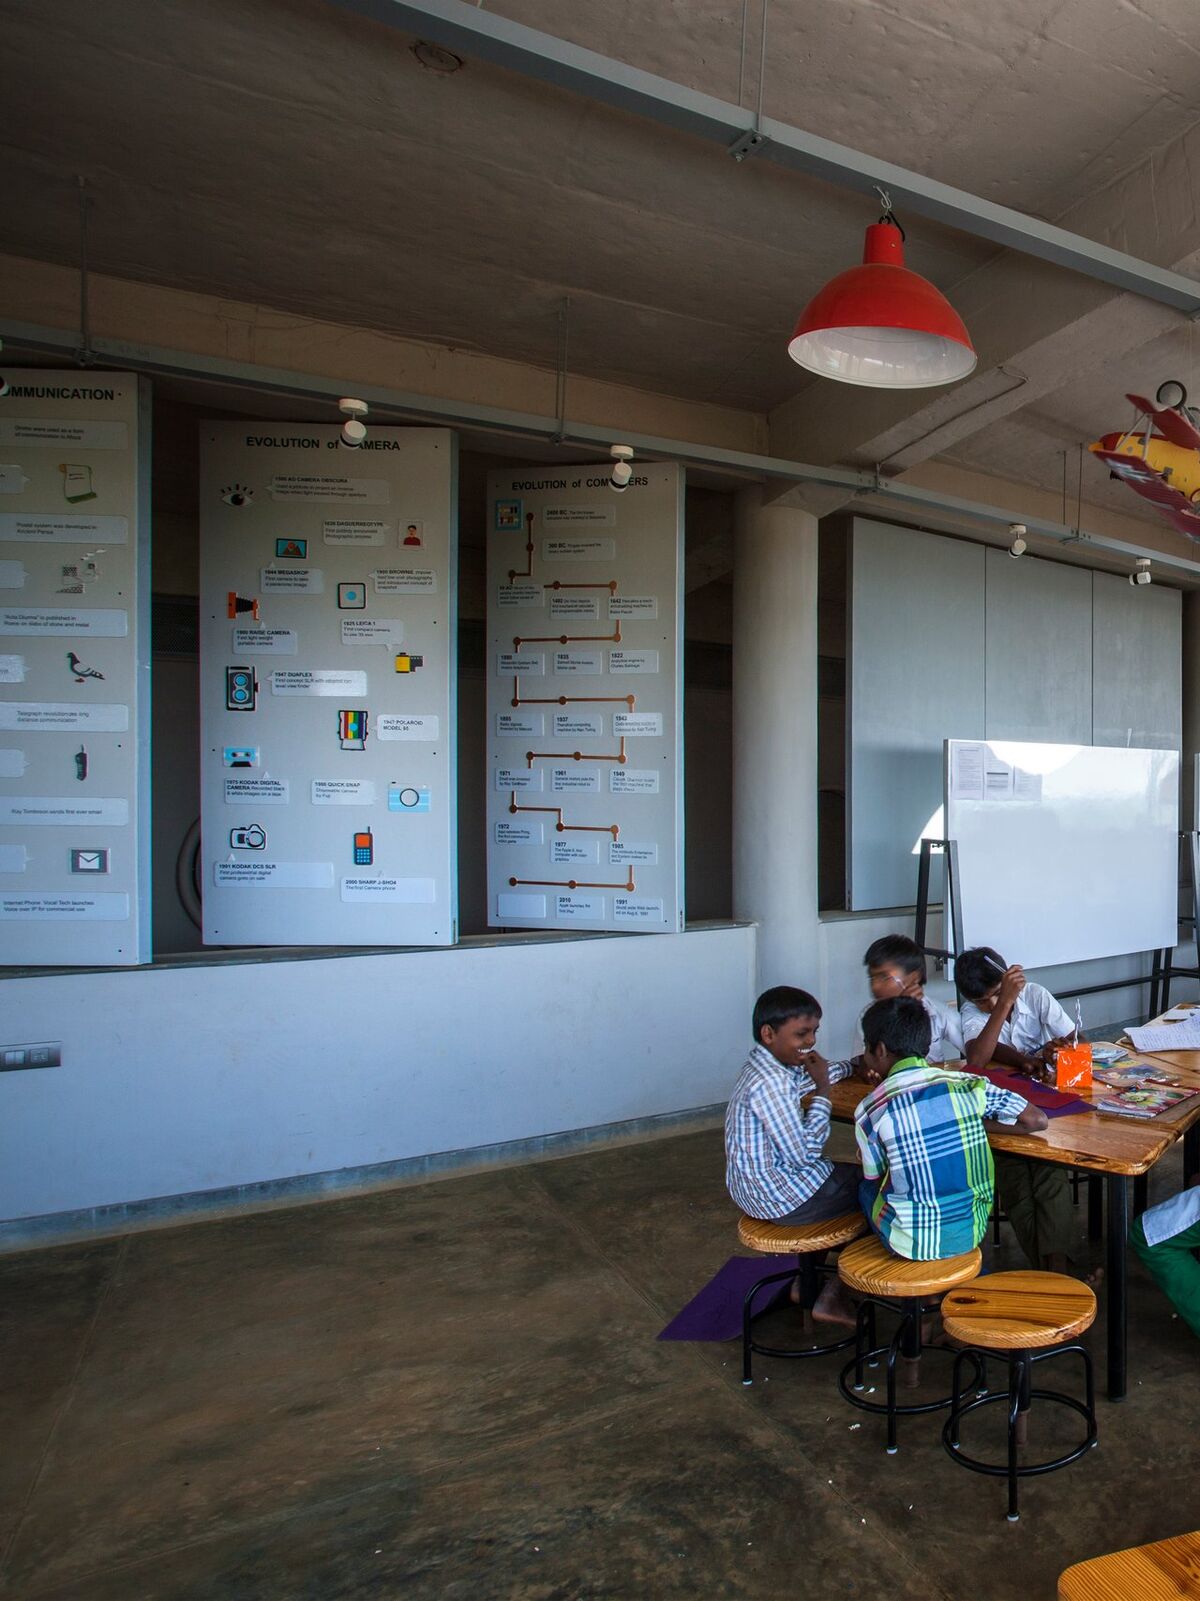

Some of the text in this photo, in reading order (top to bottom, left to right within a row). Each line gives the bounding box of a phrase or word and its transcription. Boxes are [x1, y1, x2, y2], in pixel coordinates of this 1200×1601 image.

[2, 386, 114, 401] MMUNICATION
[246, 436, 320, 449] EVOLUTION
[327, 440, 340, 450] of
[512, 480, 567, 491] EVOLUTION
[586, 477, 648, 487] COMERS
